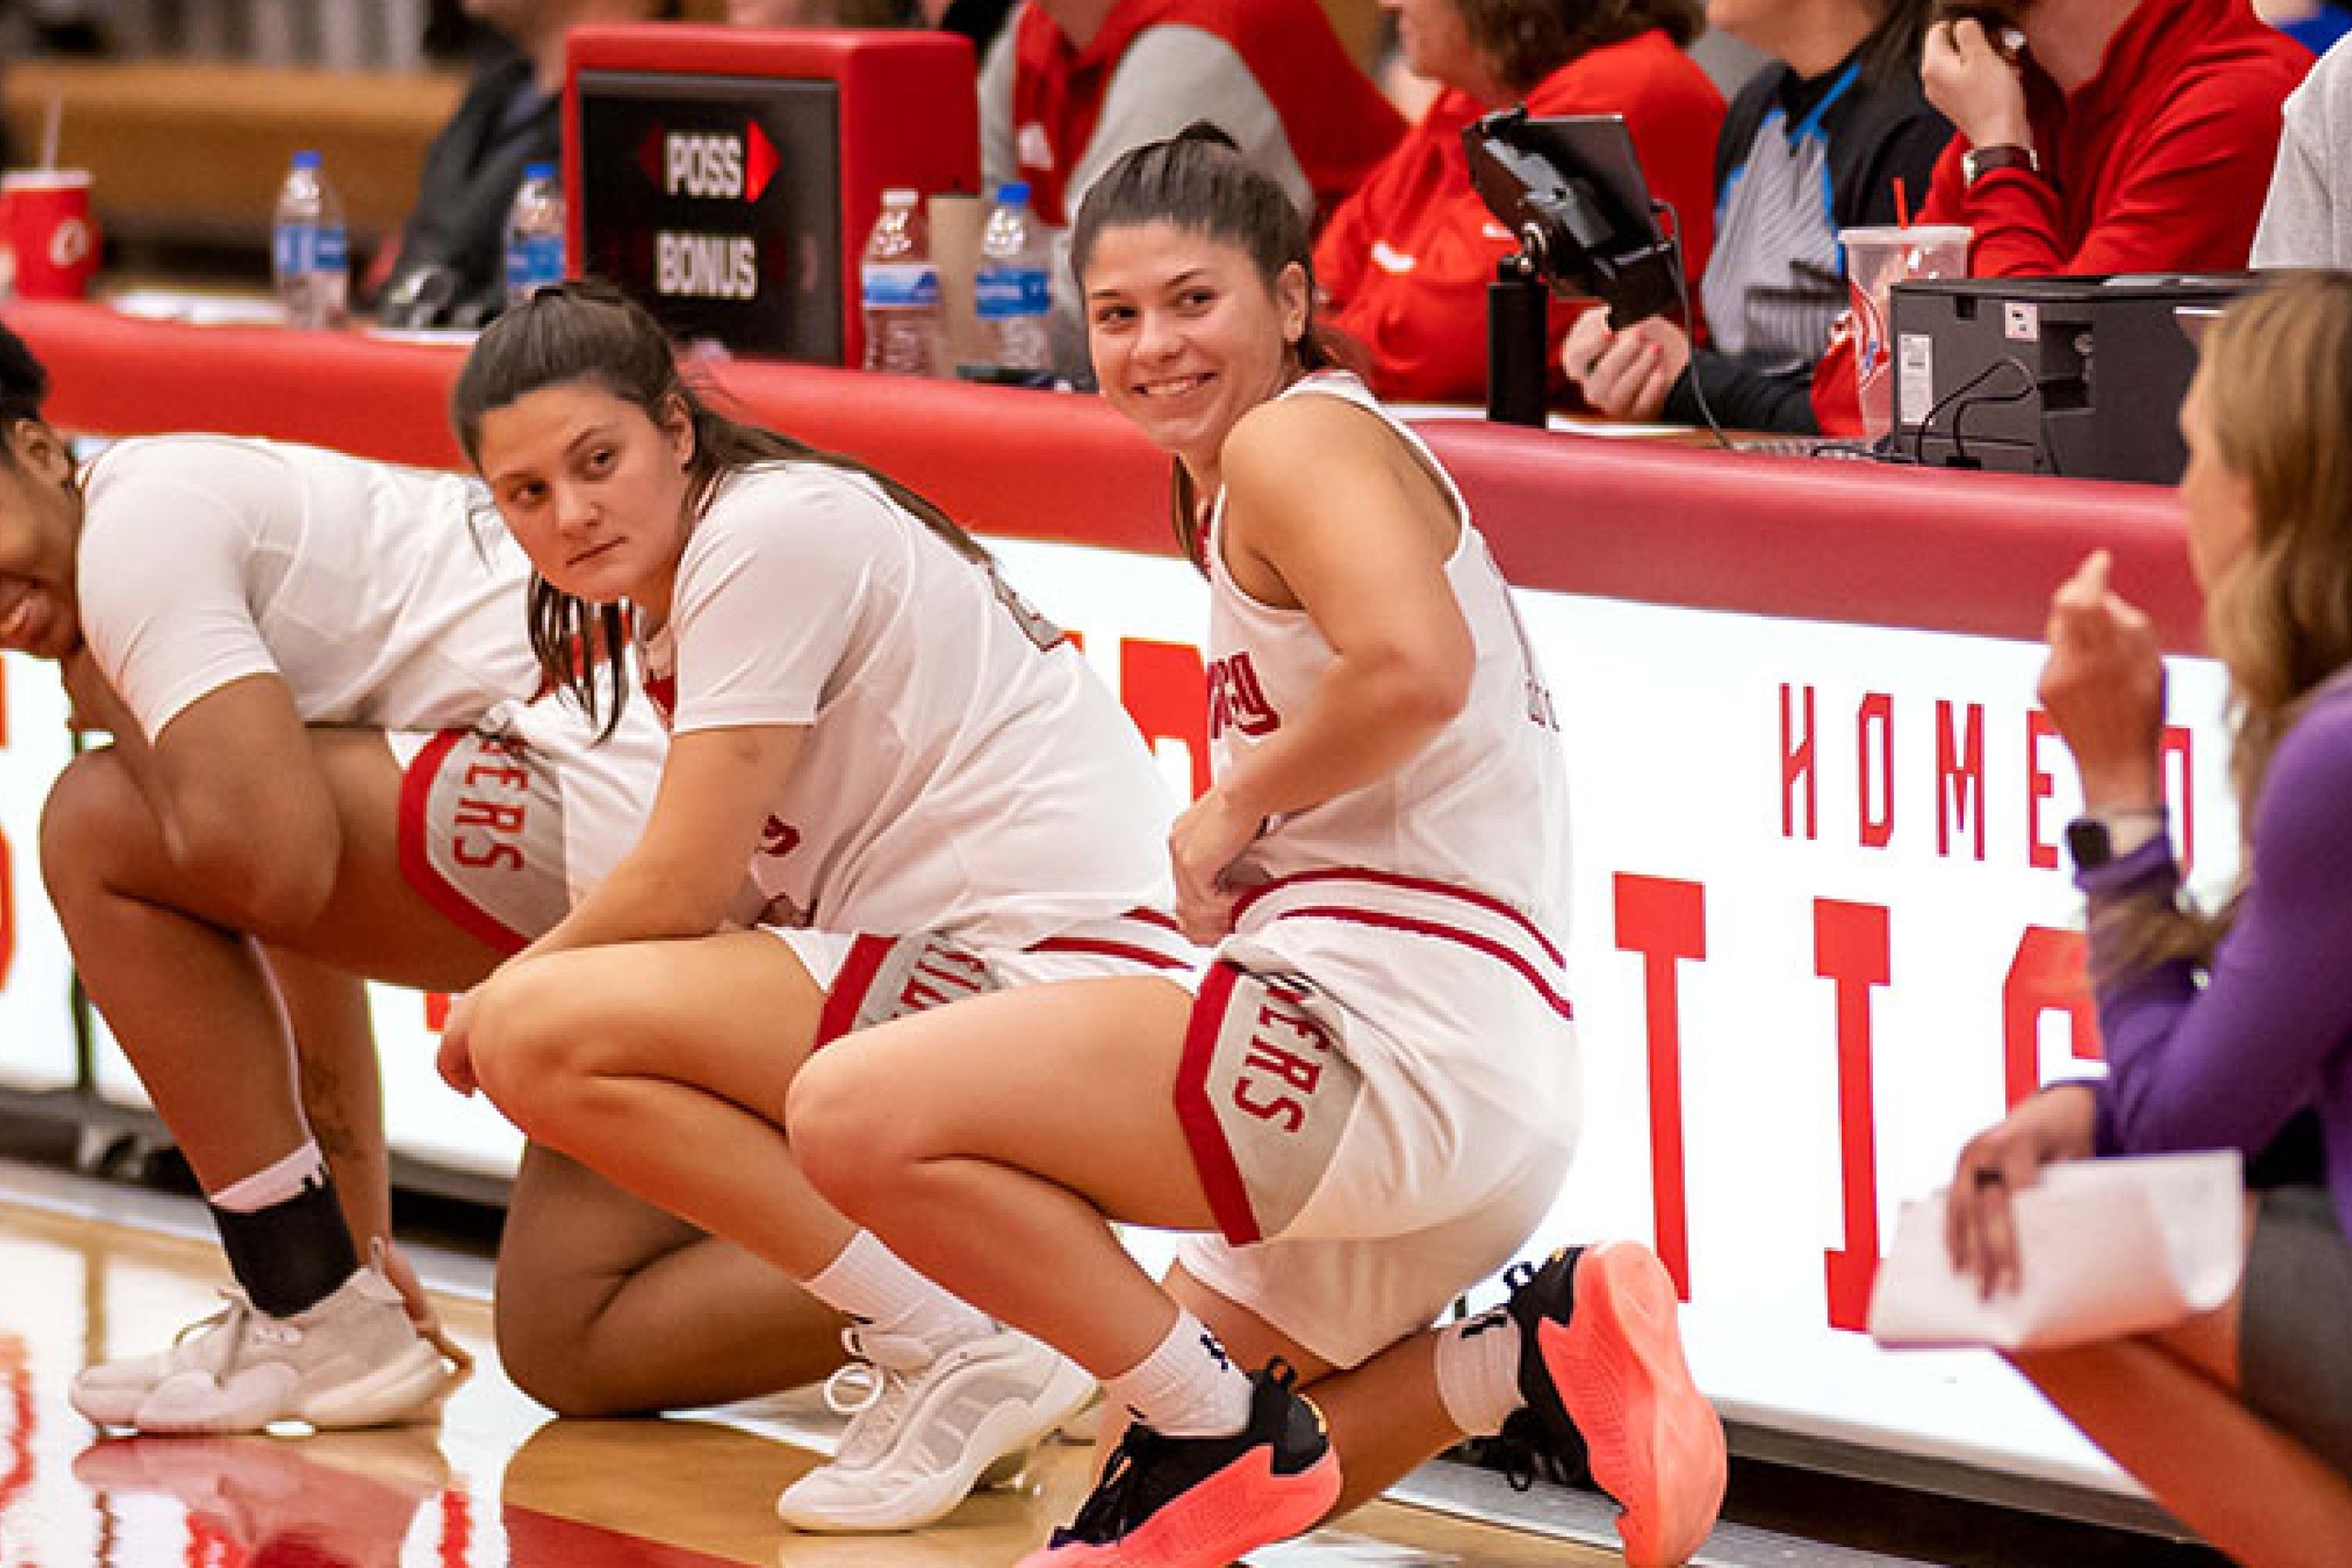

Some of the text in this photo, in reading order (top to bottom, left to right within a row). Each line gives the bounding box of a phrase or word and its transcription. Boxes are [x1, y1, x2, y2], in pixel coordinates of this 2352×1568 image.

[666, 133, 743, 199] POSS
[655, 231, 757, 301] BONUS
[1779, 681, 2060, 870] HOME
[1233, 987, 1332, 1134] ERS
